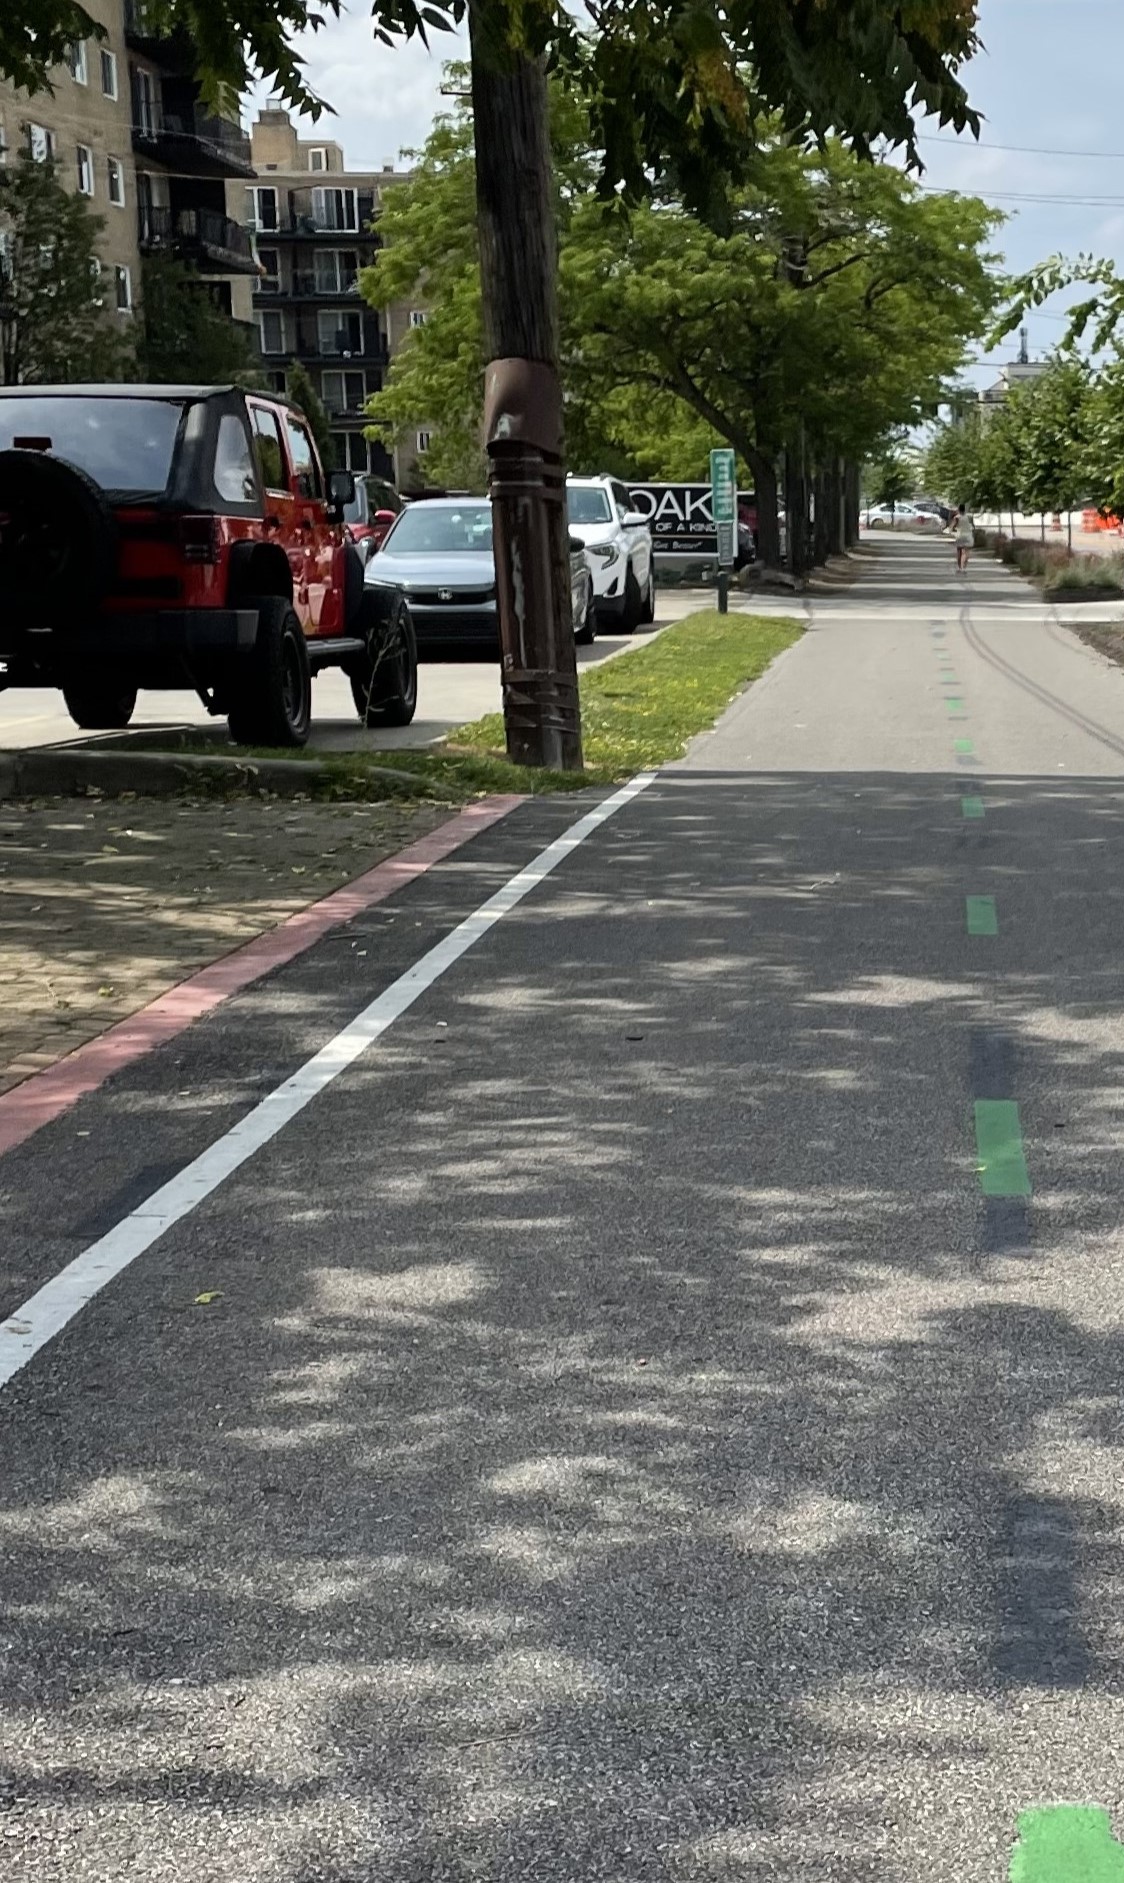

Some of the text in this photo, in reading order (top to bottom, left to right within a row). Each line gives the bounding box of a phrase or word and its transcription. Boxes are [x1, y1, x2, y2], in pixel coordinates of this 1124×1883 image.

[655, 522, 717, 532] OF A KIND
